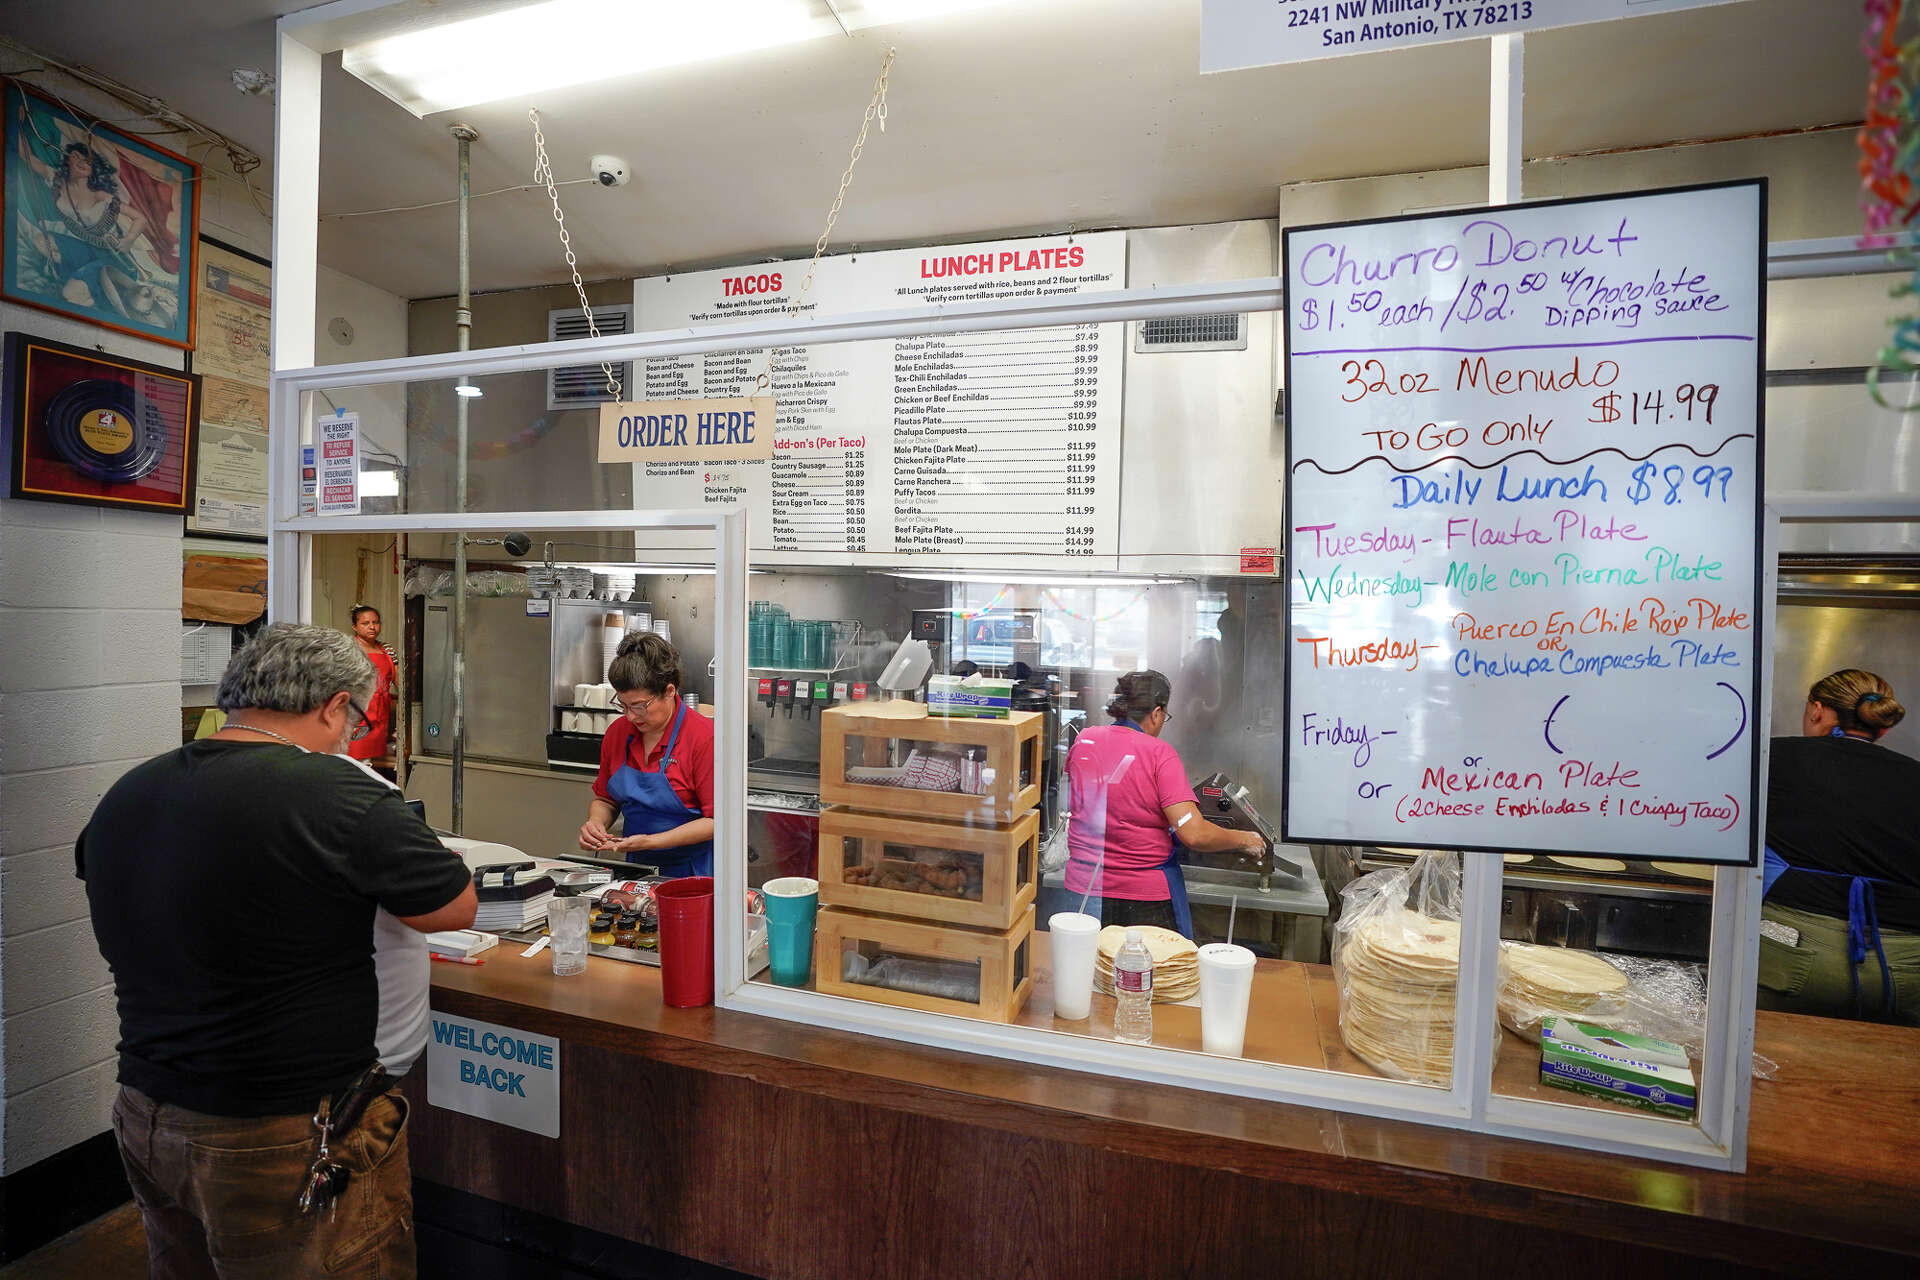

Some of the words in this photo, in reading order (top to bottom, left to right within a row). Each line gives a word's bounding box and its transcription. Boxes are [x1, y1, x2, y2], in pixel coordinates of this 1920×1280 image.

[1288, 6, 1328, 27] 2241
[1336, 0, 1367, 21] NW
[1323, 29, 1355, 46] San
[1360, 15, 1438, 41] Antonio,
[1443, 10, 1467, 30] TX
[1473, 1, 1532, 26] 78213
[921, 254, 993, 278] LUNCH
[999, 247, 1083, 272] PLATES
[1300, 242, 1458, 286] Churro
[1462, 220, 1638, 267] Donut
[722, 273, 782, 296] TACOS
[908, 286, 928, 294] Lunch
[930, 285, 951, 293] plates
[953, 283, 977, 291] served
[1060, 275, 1077, 283] flour
[966, 292, 994, 300] tortillas
[996, 290, 1013, 298] upon
[1015, 288, 1034, 296] order
[724, 309, 747, 317] tortillas
[1545, 303, 1642, 328] Dipping
[1076, 333, 1098, 341] $7.49
[923, 351, 963, 359] Enchiladas
[1075, 344, 1098, 352] $8.99
[895, 364, 912, 372] Mole
[914, 363, 953, 371] Enchiladas
[1075, 355, 1098, 363] $9.99
[895, 374, 925, 382] Tex-Chili
[1075, 367, 1097, 375] $9.99
[895, 385, 915, 393] Green
[918, 384, 957, 392] Enchiladas
[1074, 378, 1097, 386] $9.99
[1457, 357, 1618, 394] Menudo
[704, 386, 728, 394] Country
[729, 385, 740, 393] Egg
[1074, 400, 1096, 408] $9.99
[1588, 384, 1720, 425] $14.99
[618, 414, 688, 447] ORDER
[696, 411, 756, 445] HERE
[894, 428, 923, 436] Chalupa
[1068, 423, 1096, 431] $10.99
[1417, 423, 1468, 450] GO
[1483, 414, 1553, 444] Only
[817, 437, 836, 448] (Per
[838, 436, 865, 448] Taco)
[799, 462, 826, 470] Sausage
[1391, 469, 1483, 508] Daily
[1497, 465, 1607, 503] Lunch
[1627, 462, 1733, 505] $8.99
[913, 526, 932, 534] Fajita
[934, 536, 963, 544] (Breast)
[1447, 517, 1552, 550] Flauta
[1554, 509, 1648, 543] Plate
[1445, 561, 1497, 598] Mole
[1509, 567, 1548, 588] con
[1554, 552, 1649, 585] Pierna
[1645, 547, 1722, 581] Plate
[1452, 613, 1538, 642] Puerco
[1545, 611, 1574, 636] En
[1580, 606, 1638, 636] Chile
[1640, 598, 1688, 637] Rojo
[1689, 598, 1750, 632] Plate
[1538, 636, 1568, 653] OR
[1560, 649, 1671, 676] Compuesta
[1672, 639, 1740, 668] Plate
[1463, 755, 1483, 767] or
[1422, 764, 1542, 792] Mexican
[1560, 761, 1640, 789] Plate
[1497, 797, 1590, 816] Enchiladas
[1618, 800, 1624, 816] 1
[1694, 795, 1740, 832] Taco)
[432, 1020, 553, 1070] WELCOME
[460, 1059, 526, 1098] BACK
[1554, 1061, 1577, 1073] Rite
[1579, 1067, 1612, 1082] Wrap
